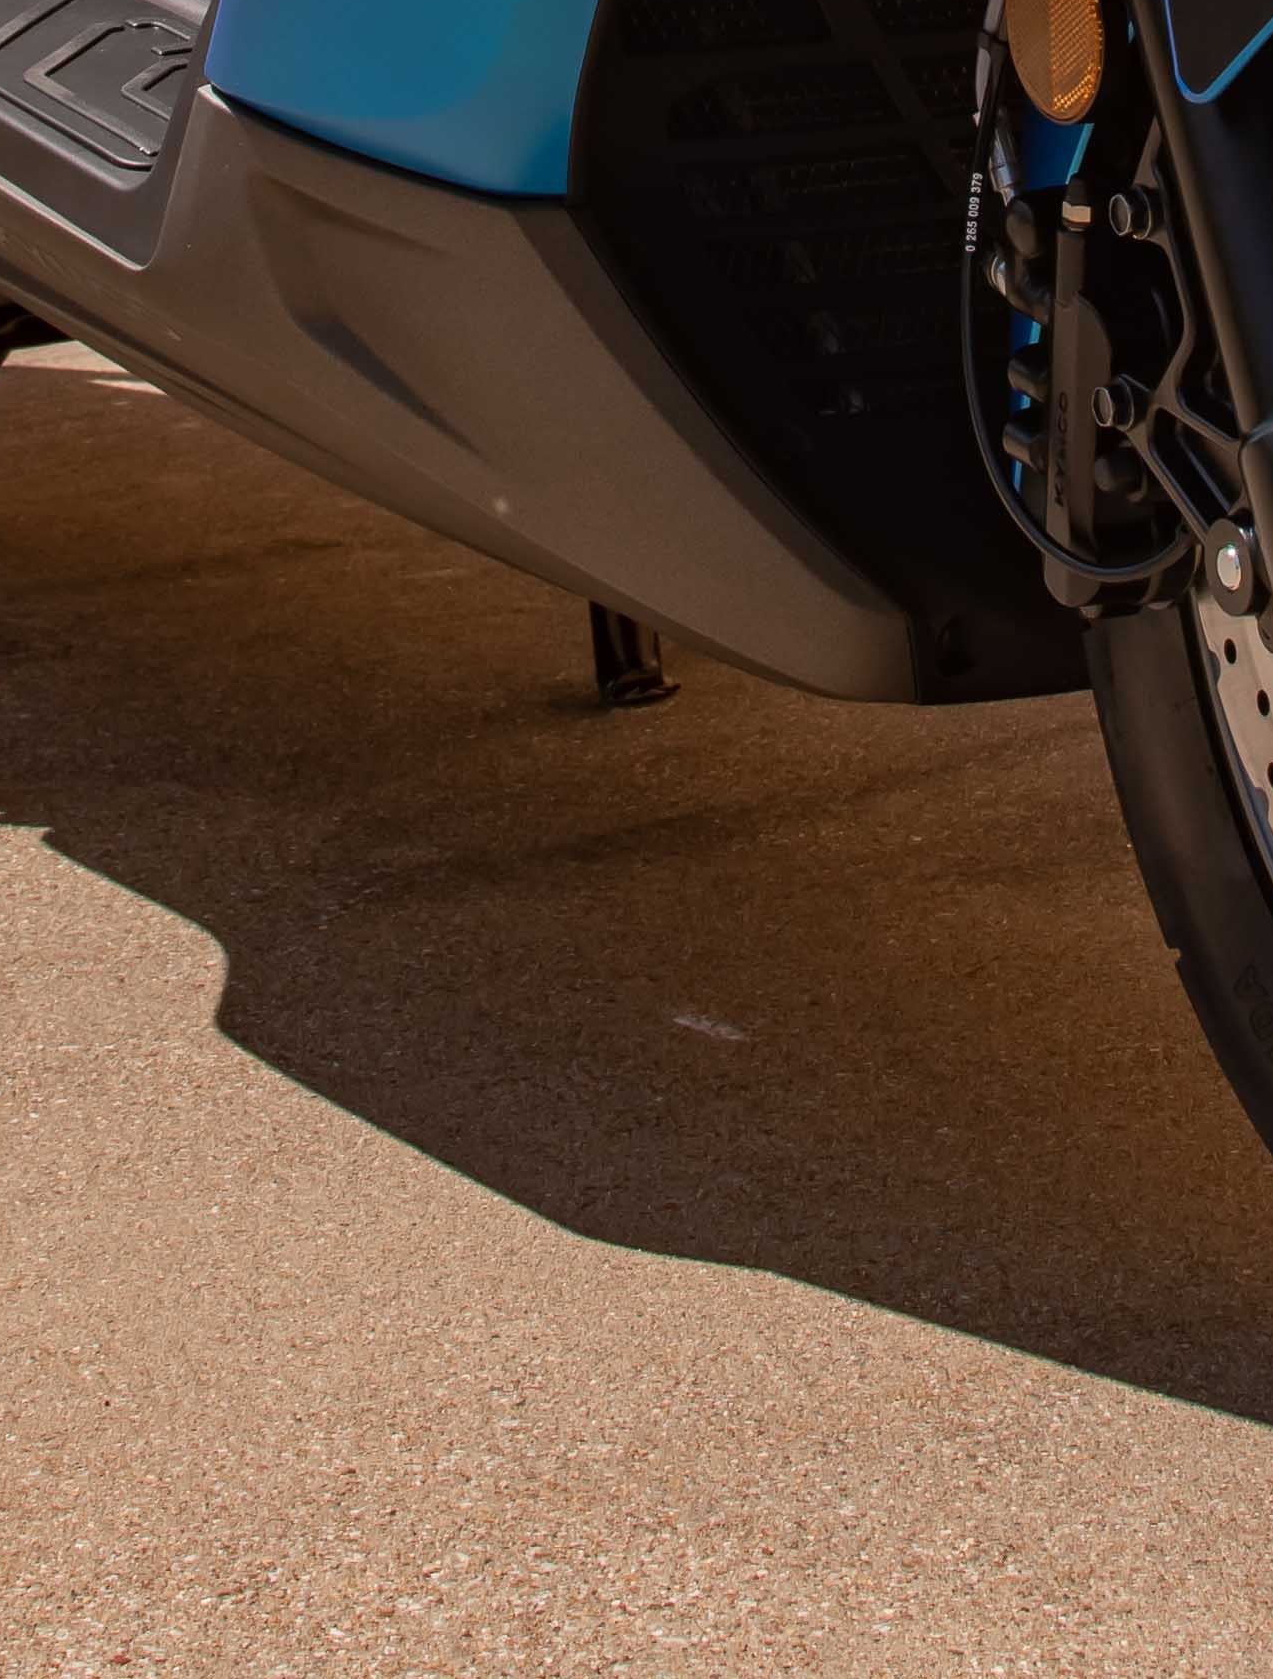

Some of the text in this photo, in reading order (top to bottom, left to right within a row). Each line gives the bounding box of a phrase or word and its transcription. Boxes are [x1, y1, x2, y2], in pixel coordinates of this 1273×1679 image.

[971, 172, 984, 194] 379
[968, 196, 980, 217] 009
[966, 221, 978, 241] 265
